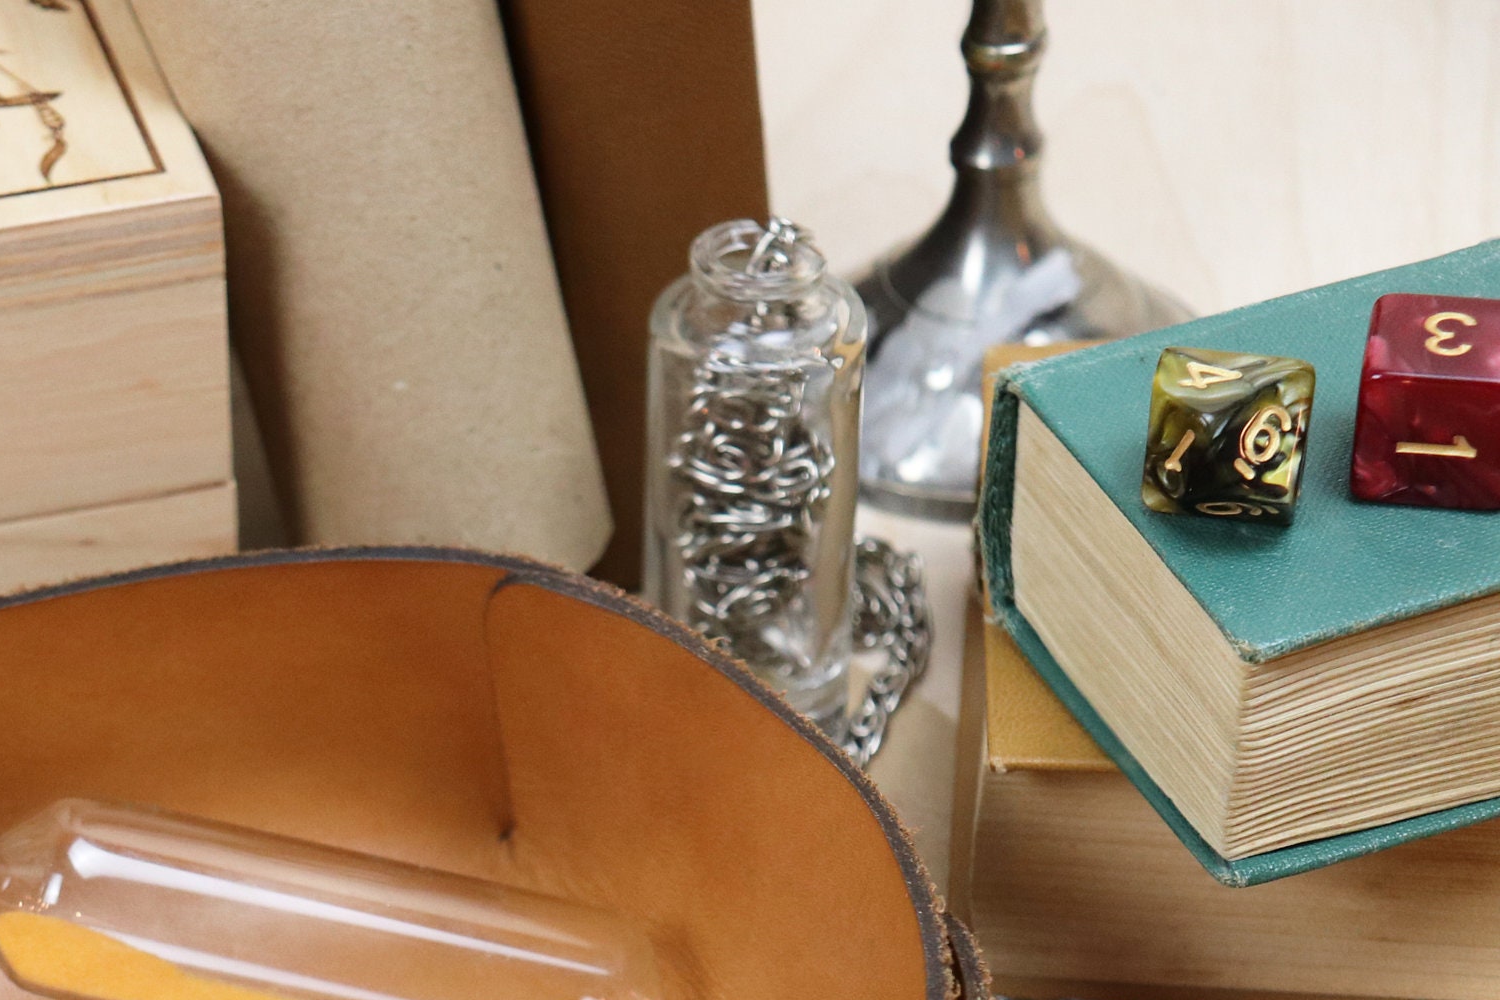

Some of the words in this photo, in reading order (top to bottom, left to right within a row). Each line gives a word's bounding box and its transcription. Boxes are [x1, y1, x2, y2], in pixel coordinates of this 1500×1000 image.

[1424, 311, 1478, 356] 3
[1178, 361, 1243, 389] 4
[1164, 429, 1195, 473] 1
[1395, 434, 1478, 458] 1
